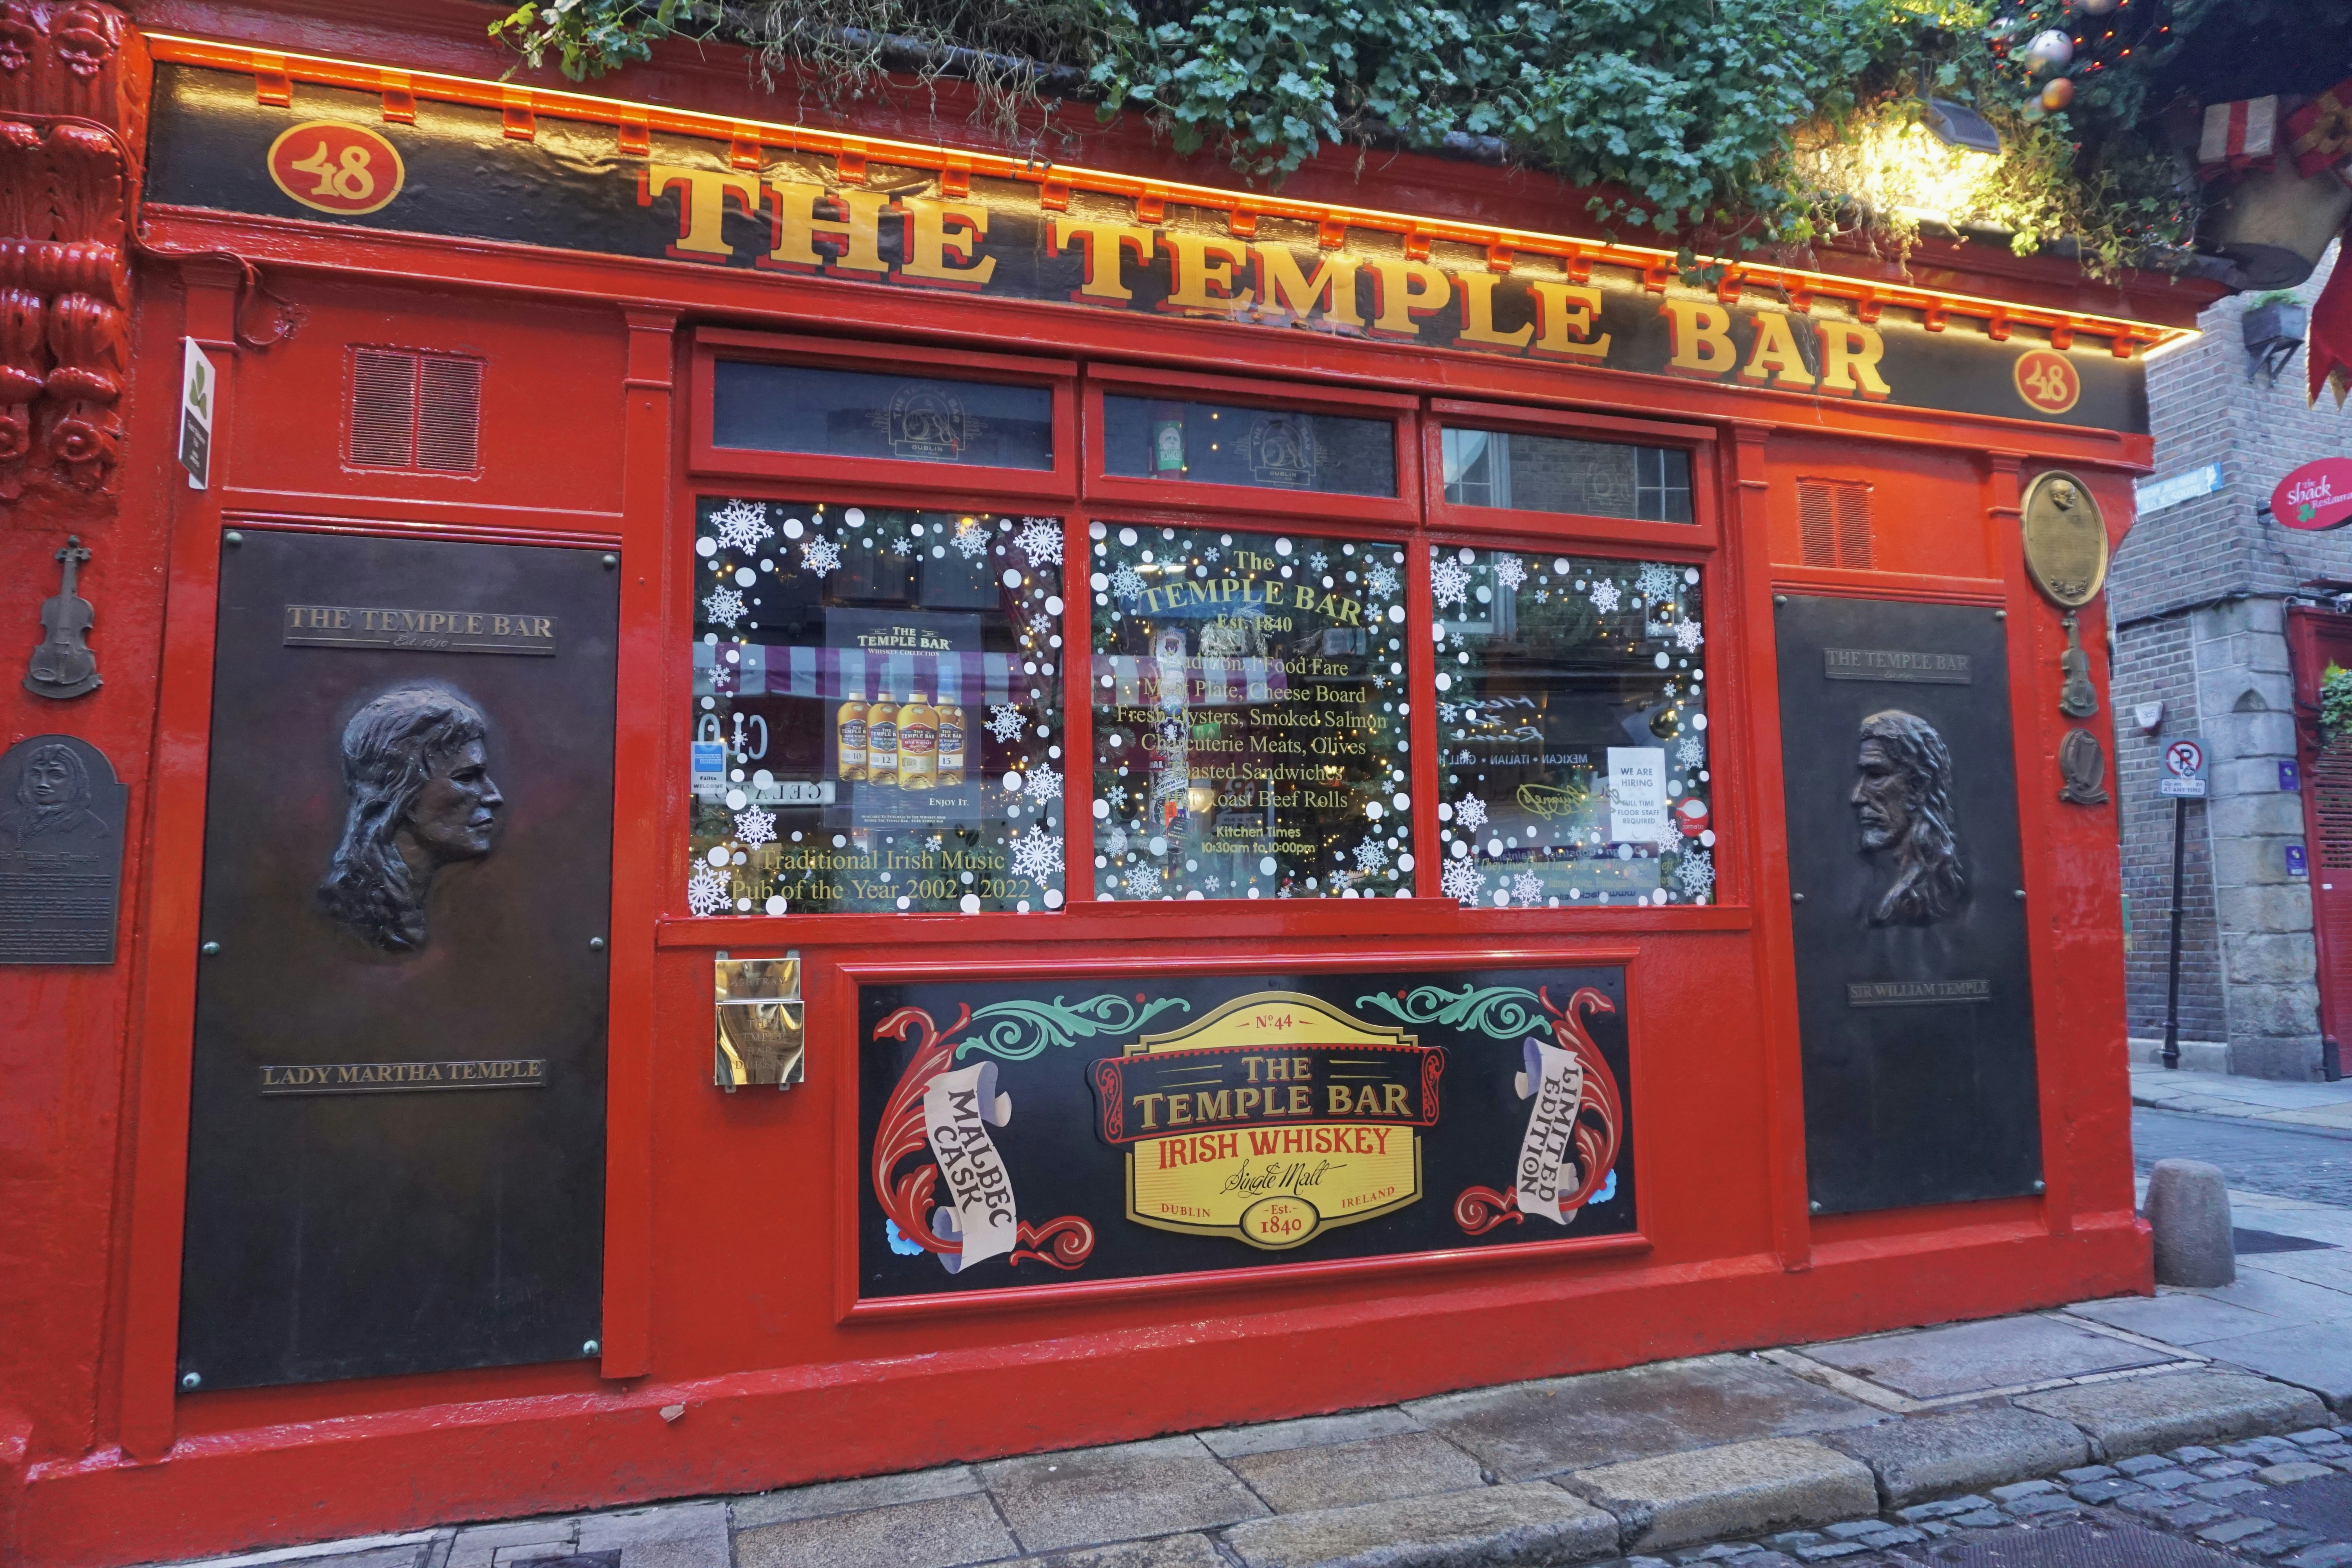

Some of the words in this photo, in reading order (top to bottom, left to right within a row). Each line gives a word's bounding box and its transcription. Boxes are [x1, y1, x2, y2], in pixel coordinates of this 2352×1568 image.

[292, 141, 375, 200] 48
[641, 165, 996, 291] THE
[1049, 220, 1611, 361] TEMPLE
[1662, 297, 1891, 403] BAR
[2025, 360, 2068, 401] 48
[2171, 484, 2200, 499] SOUTH
[2287, 475, 2332, 506] Shack
[2302, 478, 2316, 488] The
[1234, 551, 1274, 572] The
[1139, 579, 1285, 613] TEMPLE
[1294, 584, 1361, 626] BAR
[287, 607, 352, 630] THE
[360, 610, 485, 635] TEMPLE
[492, 616, 553, 637] BAR
[893, 626, 916, 636] THE
[1218, 613, 1249, 630] Est.
[1255, 616, 1292, 632] 1840
[394, 635, 417, 648] Est.
[421, 638, 448, 648] 1840
[857, 635, 916, 647] TEMPLE
[920, 637, 950, 650] BAR
[1164, 651, 1257, 673] Taditionl
[1263, 655, 1307, 675] Food
[1312, 658, 1348, 675] Fare
[1827, 650, 1860, 666] THE
[1865, 653, 1932, 670] TEMPLE
[1936, 655, 1970, 671] BAR
[1195, 680, 1243, 702] Plate,
[1249, 681, 1310, 701] Cheese
[1316, 686, 1366, 703] Board
[1116, 705, 1165, 723] Fresh
[1172, 707, 1244, 728] Oysters,
[1250, 709, 1321, 727] Smoked
[1325, 710, 1387, 729] Salmon
[1141, 733, 1244, 753] Charcuterie
[1250, 736, 1307, 756] Meats,
[1313, 737, 1366, 754] Olives
[1168, 761, 1236, 780] Toasted
[1242, 762, 1343, 781] Sandwiches
[1158, 780, 1176, 789] COURSE
[929, 798, 955, 807] ENJOY
[1208, 790, 1253, 807] Roast
[1258, 790, 1299, 808] Beef
[1304, 791, 1348, 808] Rolls
[1216, 826, 1263, 838] Kitchen
[1266, 826, 1301, 838] Times
[759, 850, 878, 870] Traditional
[887, 849, 935, 870] Irish
[941, 850, 1005, 869] Music
[1201, 842, 1249, 854] 10:30am
[1253, 842, 1266, 854] to
[1269, 842, 1315, 856] 10:00pm
[1505, 858, 1529, 871] lived
[731, 880, 773, 900] Pub
[781, 879, 804, 900] of
[811, 880, 843, 900] the
[851, 880, 899, 900] Year
[907, 879, 957, 898] 2002
[980, 879, 1030, 898] 2022
[1548, 877, 1569, 888] James
[731, 977, 788, 987] ASHTRAY
[1850, 985, 1873, 998] SIR
[1875, 984, 1935, 997] WILLIAM
[1939, 981, 1989, 995] TEMPLE
[747, 1019, 775, 1028] THE
[734, 1032, 785, 1041] TEMPLE
[748, 1046, 771, 1055] BAR
[263, 1067, 332, 1085] LADY
[337, 1063, 443, 1083] MARTHA
[446, 1061, 542, 1080] TEMPLE
[735, 1060, 784, 1069] DUBLIN
[1241, 1056, 1312, 1083] THE
[1133, 1085, 1312, 1129] TEMPLE
[1328, 1083, 1413, 1117] BAR
[1520, 1076, 1561, 1195] EDITION
[1539, 1066, 1579, 1202] LIMITED
[948, 1088, 1013, 1228] MALBEC
[1158, 1132, 1238, 1170] IRISH
[1248, 1127, 1392, 1156] WHISKEY
[933, 1125, 983, 1214] CASK
[1220, 1159, 1277, 1199] Single
[1277, 1159, 1348, 1196] Malt
[1341, 1186, 1396, 1209] IRELAND
[1161, 1203, 1211, 1218] DUBLIN
[1260, 1218, 1302, 1236] 1840
